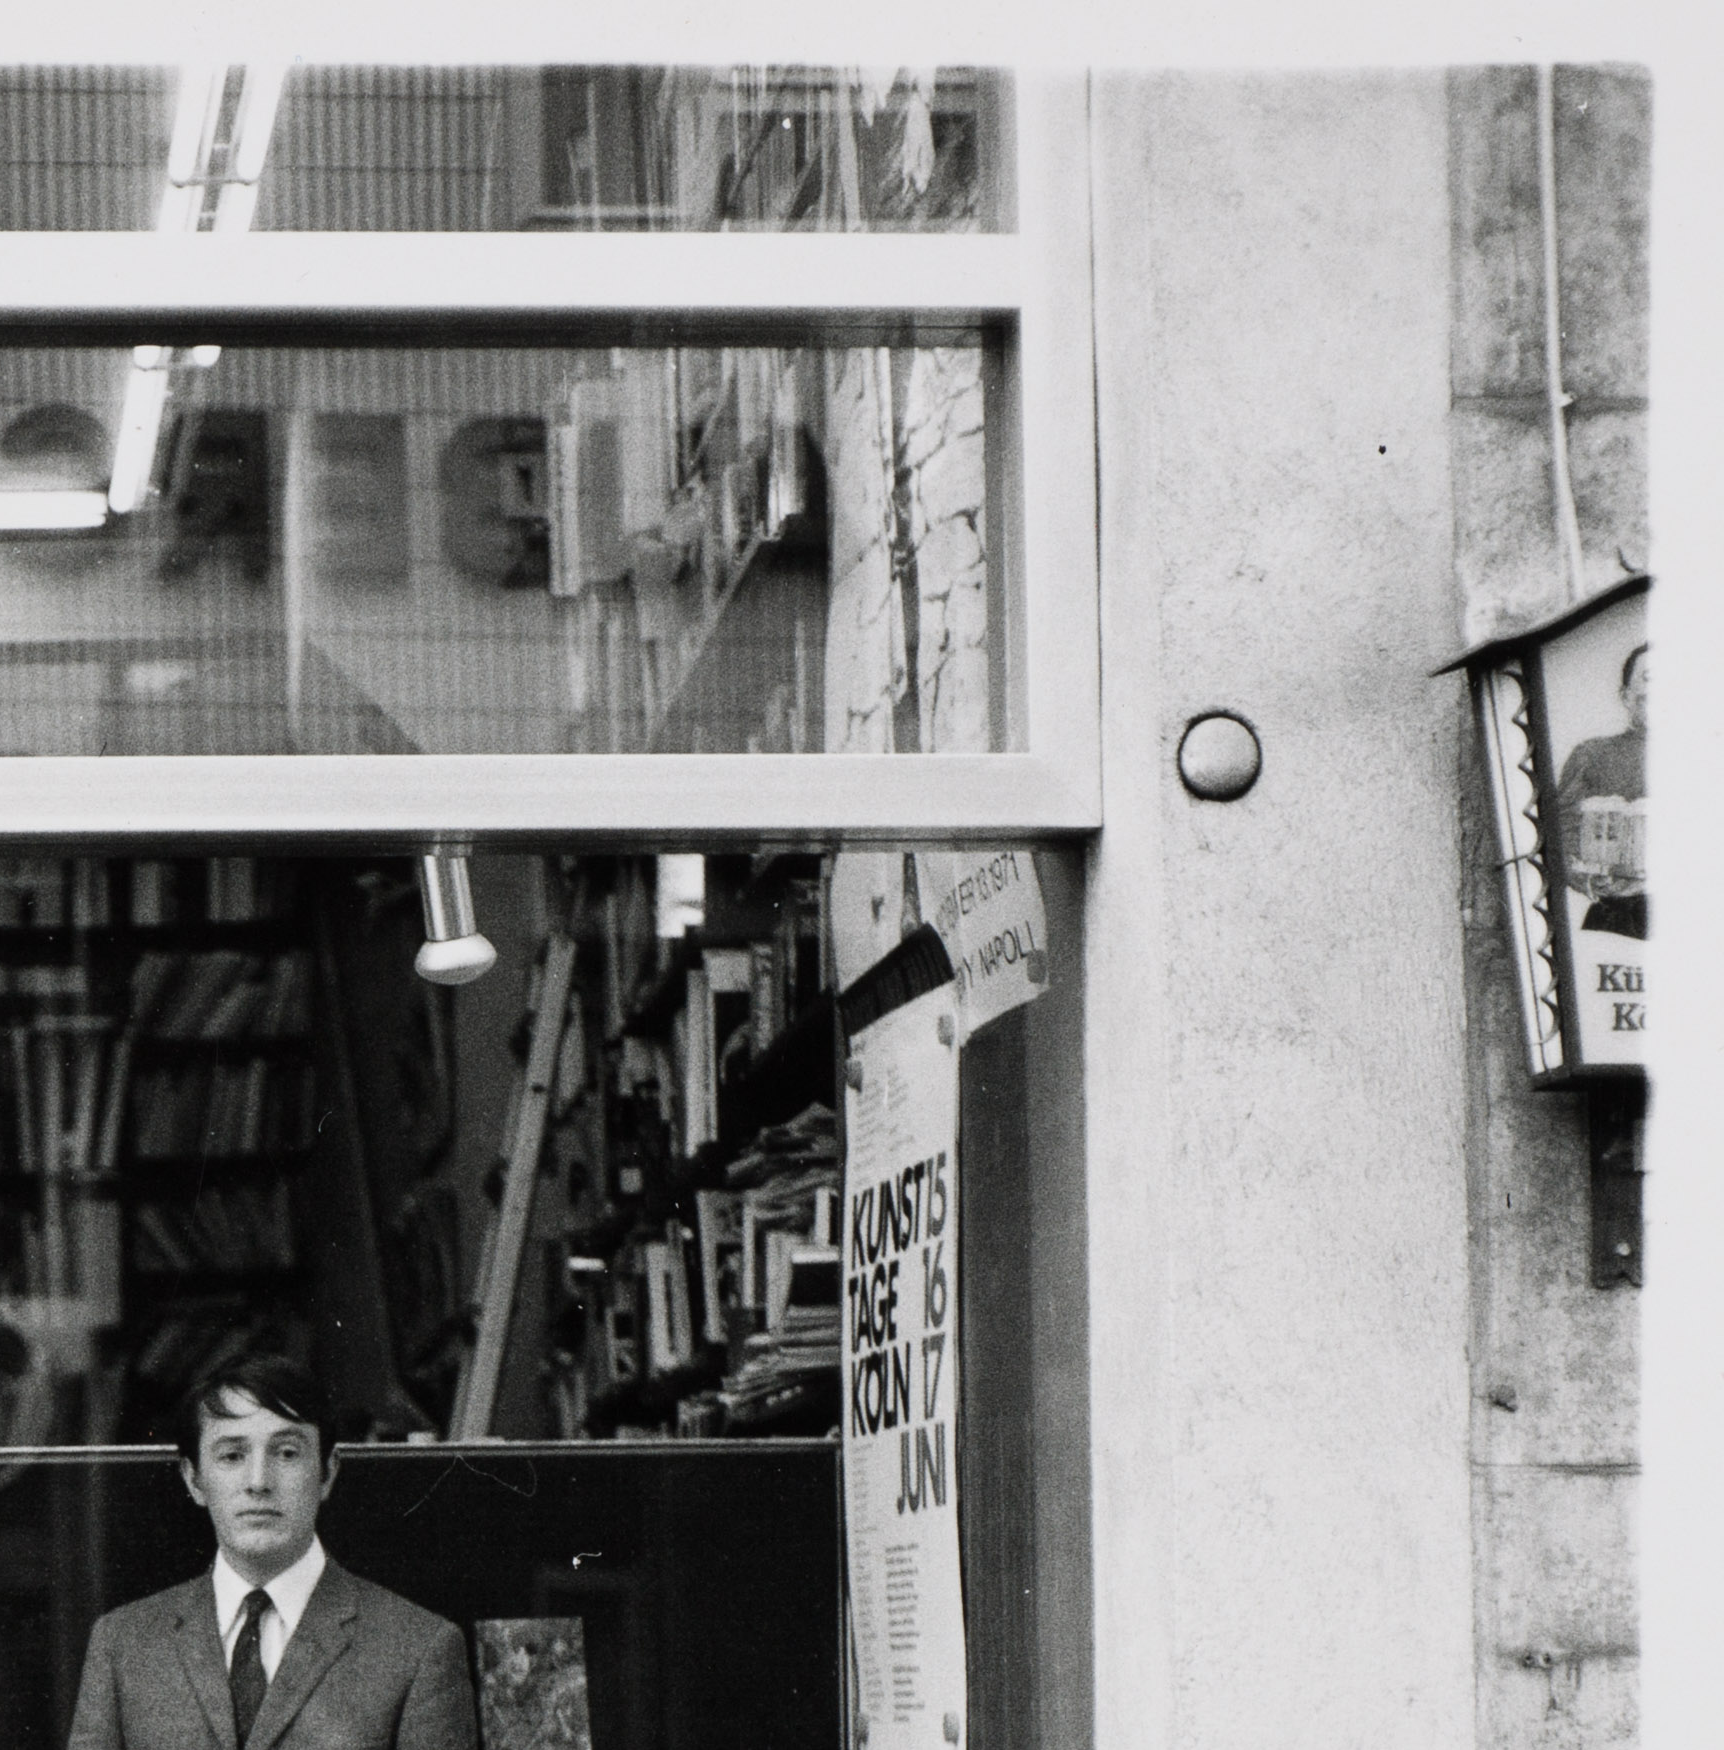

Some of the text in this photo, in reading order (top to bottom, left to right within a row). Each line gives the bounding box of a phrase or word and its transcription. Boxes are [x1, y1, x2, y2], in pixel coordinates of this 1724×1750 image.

[978, 920, 1036, 972] NAPOLI
[852, 1151, 946, 1271] KUNST 15
[849, 1241, 947, 1353] TAGE 16
[922, 1332, 945, 1420] 17
[897, 1421, 946, 1515] JUNI
